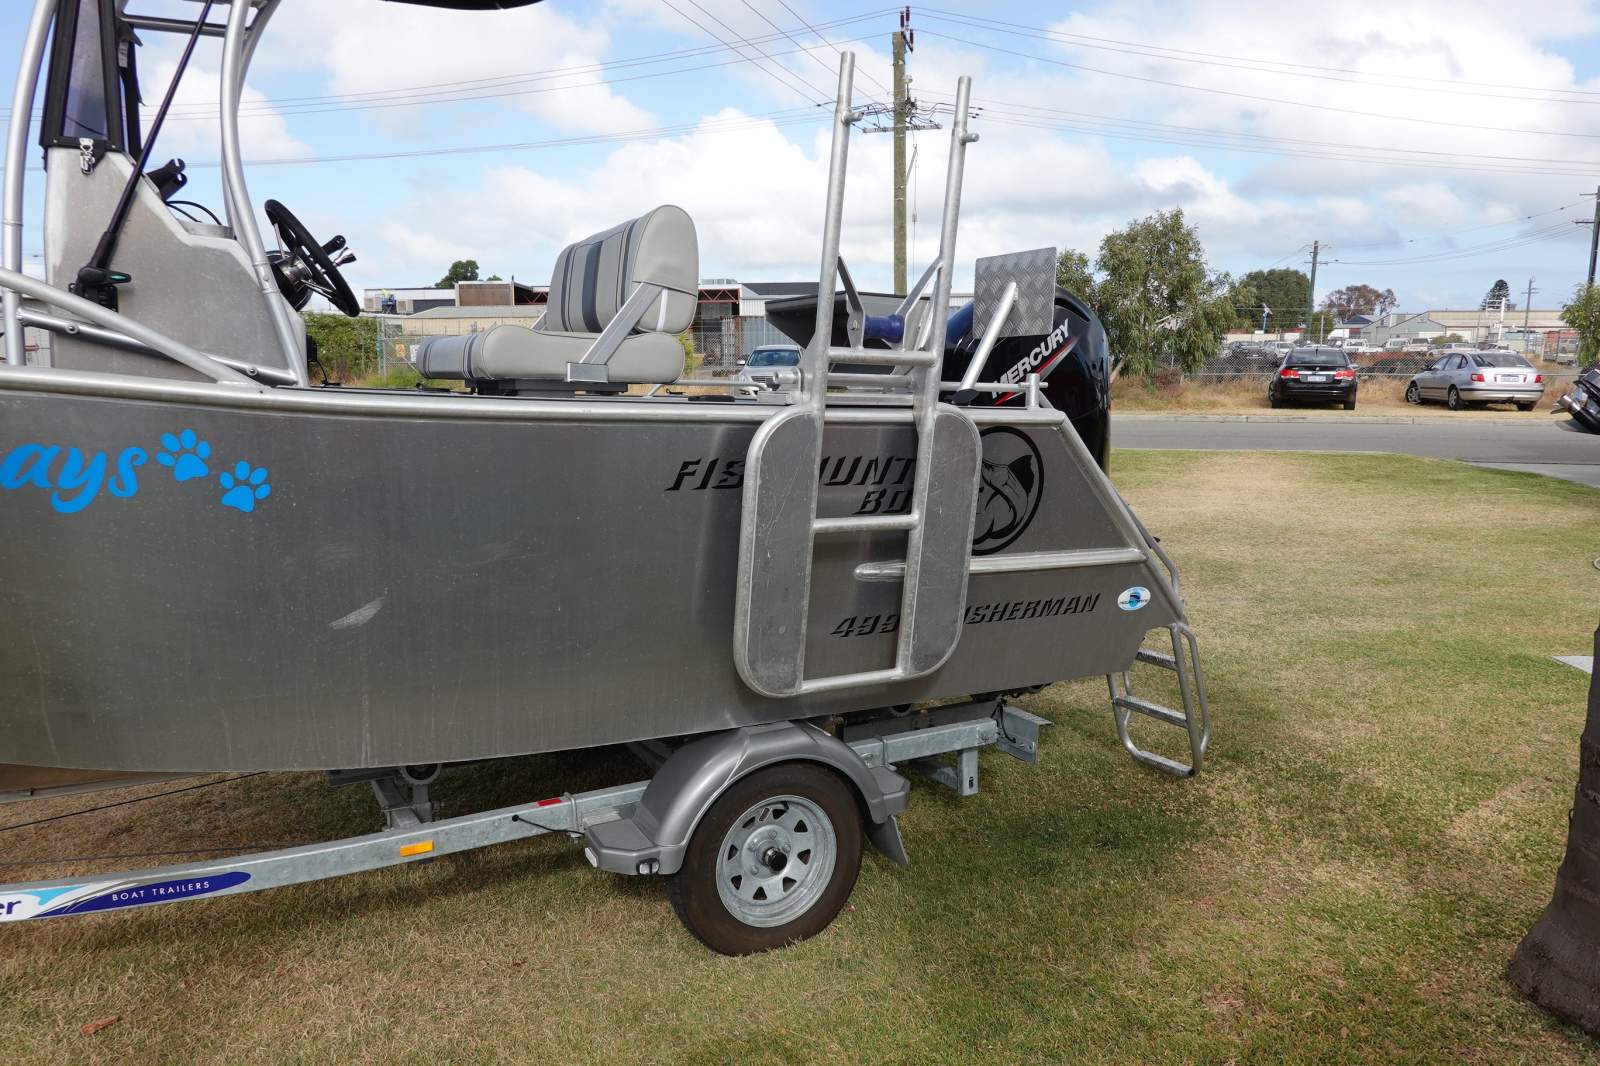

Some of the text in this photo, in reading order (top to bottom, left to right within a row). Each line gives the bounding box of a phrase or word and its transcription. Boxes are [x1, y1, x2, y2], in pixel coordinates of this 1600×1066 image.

[664, 457, 745, 491] FIS
[962, 593, 1101, 625] ISHERMAN
[112, 890, 145, 901] BOAT
[152, 881, 210, 896] TRAILERS
